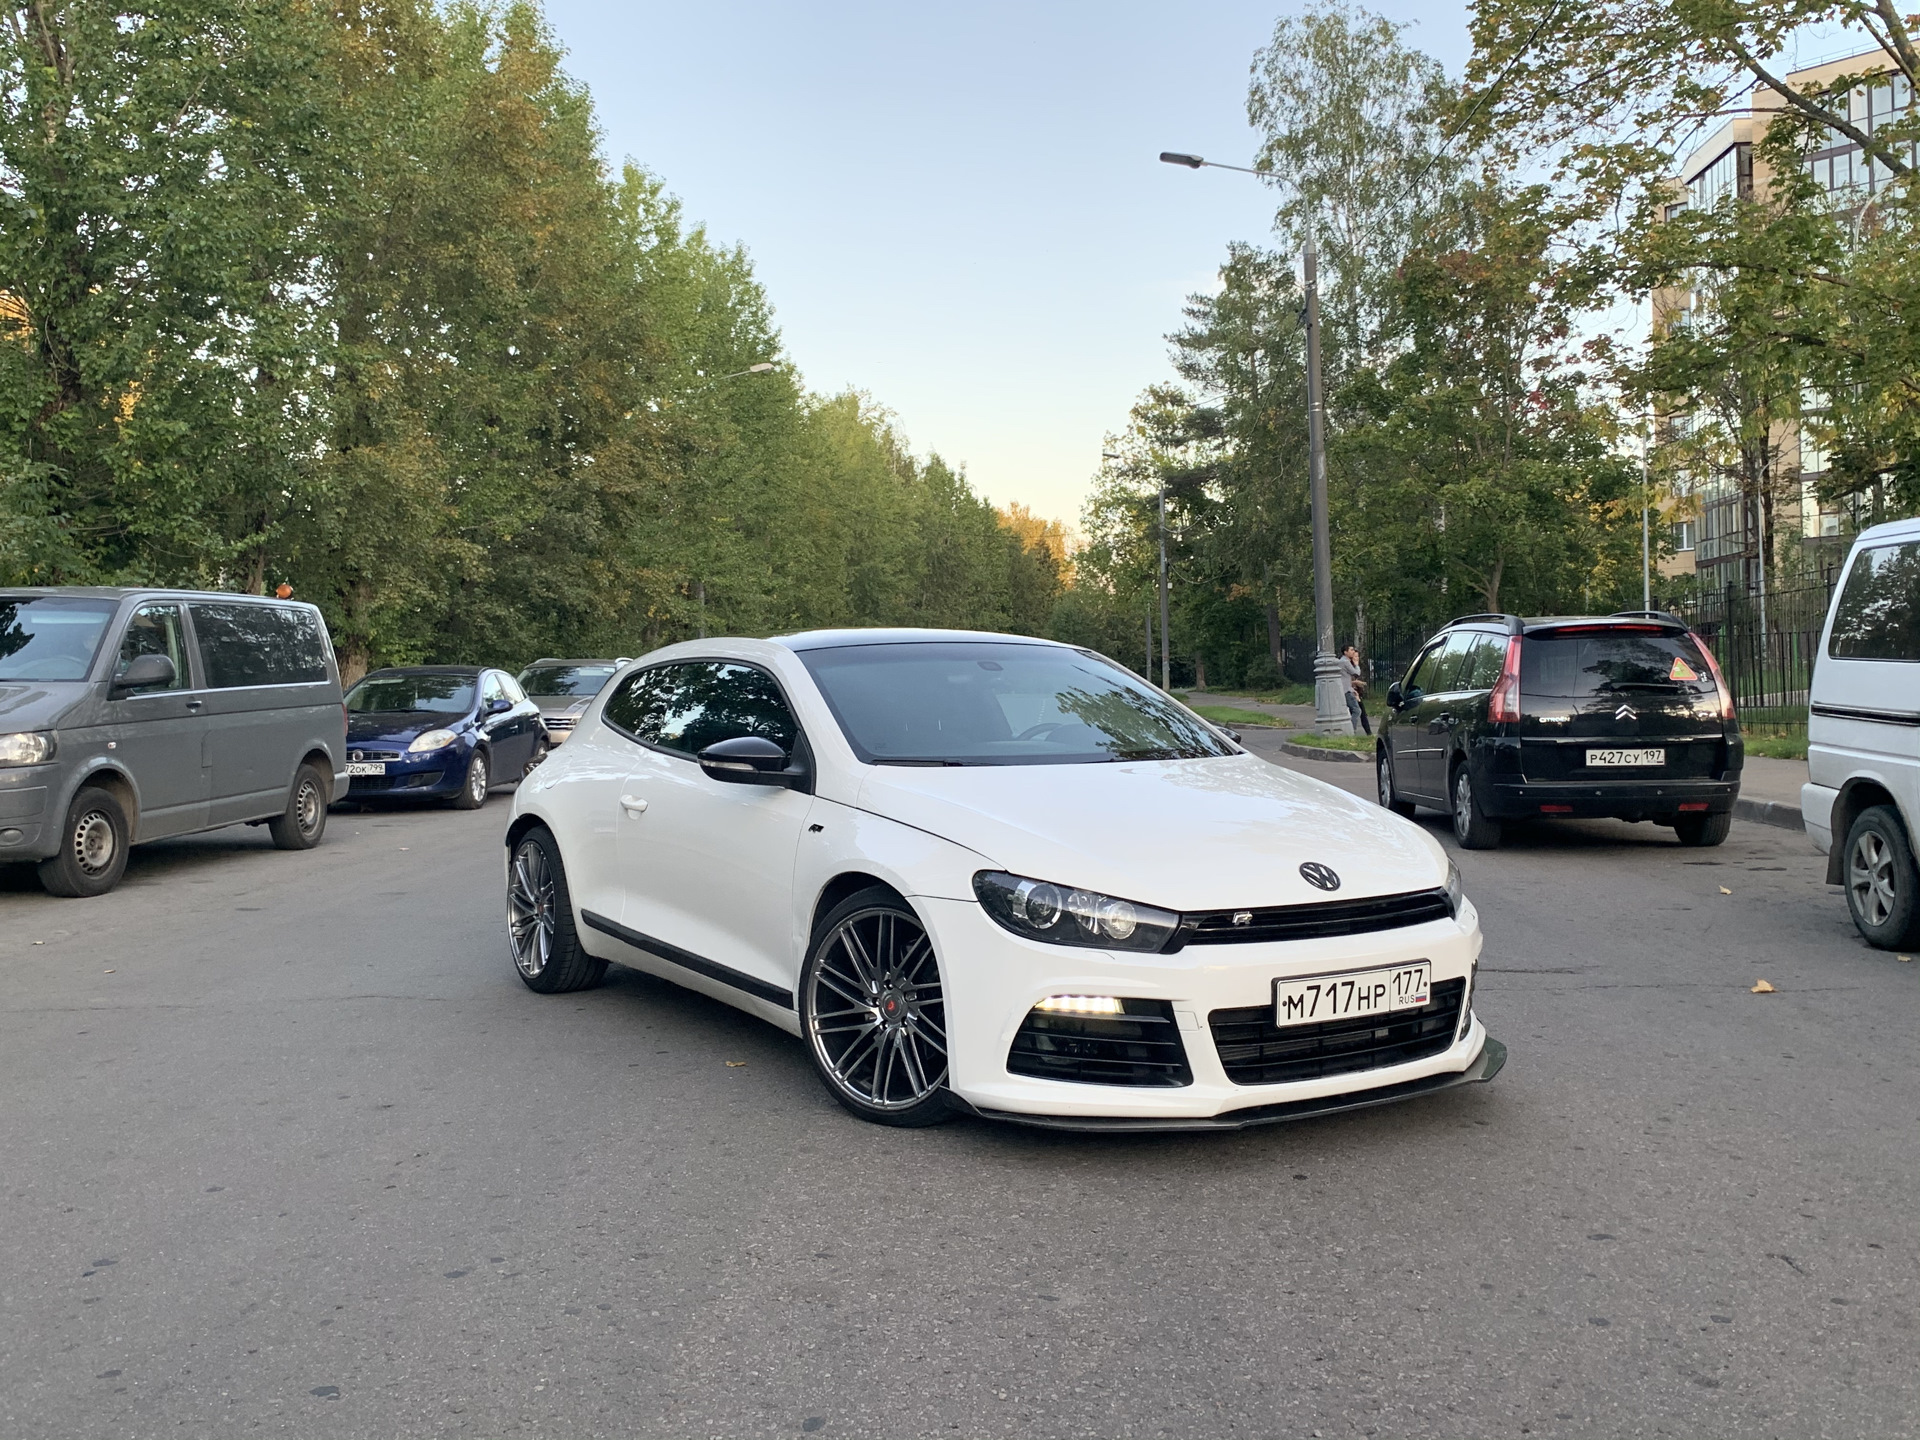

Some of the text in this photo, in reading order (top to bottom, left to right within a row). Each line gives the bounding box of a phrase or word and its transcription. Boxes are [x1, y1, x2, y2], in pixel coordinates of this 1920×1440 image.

[1643, 749, 1662, 760] 197
[1392, 968, 1423, 995] 177
[1398, 994, 1415, 1005] RUS
